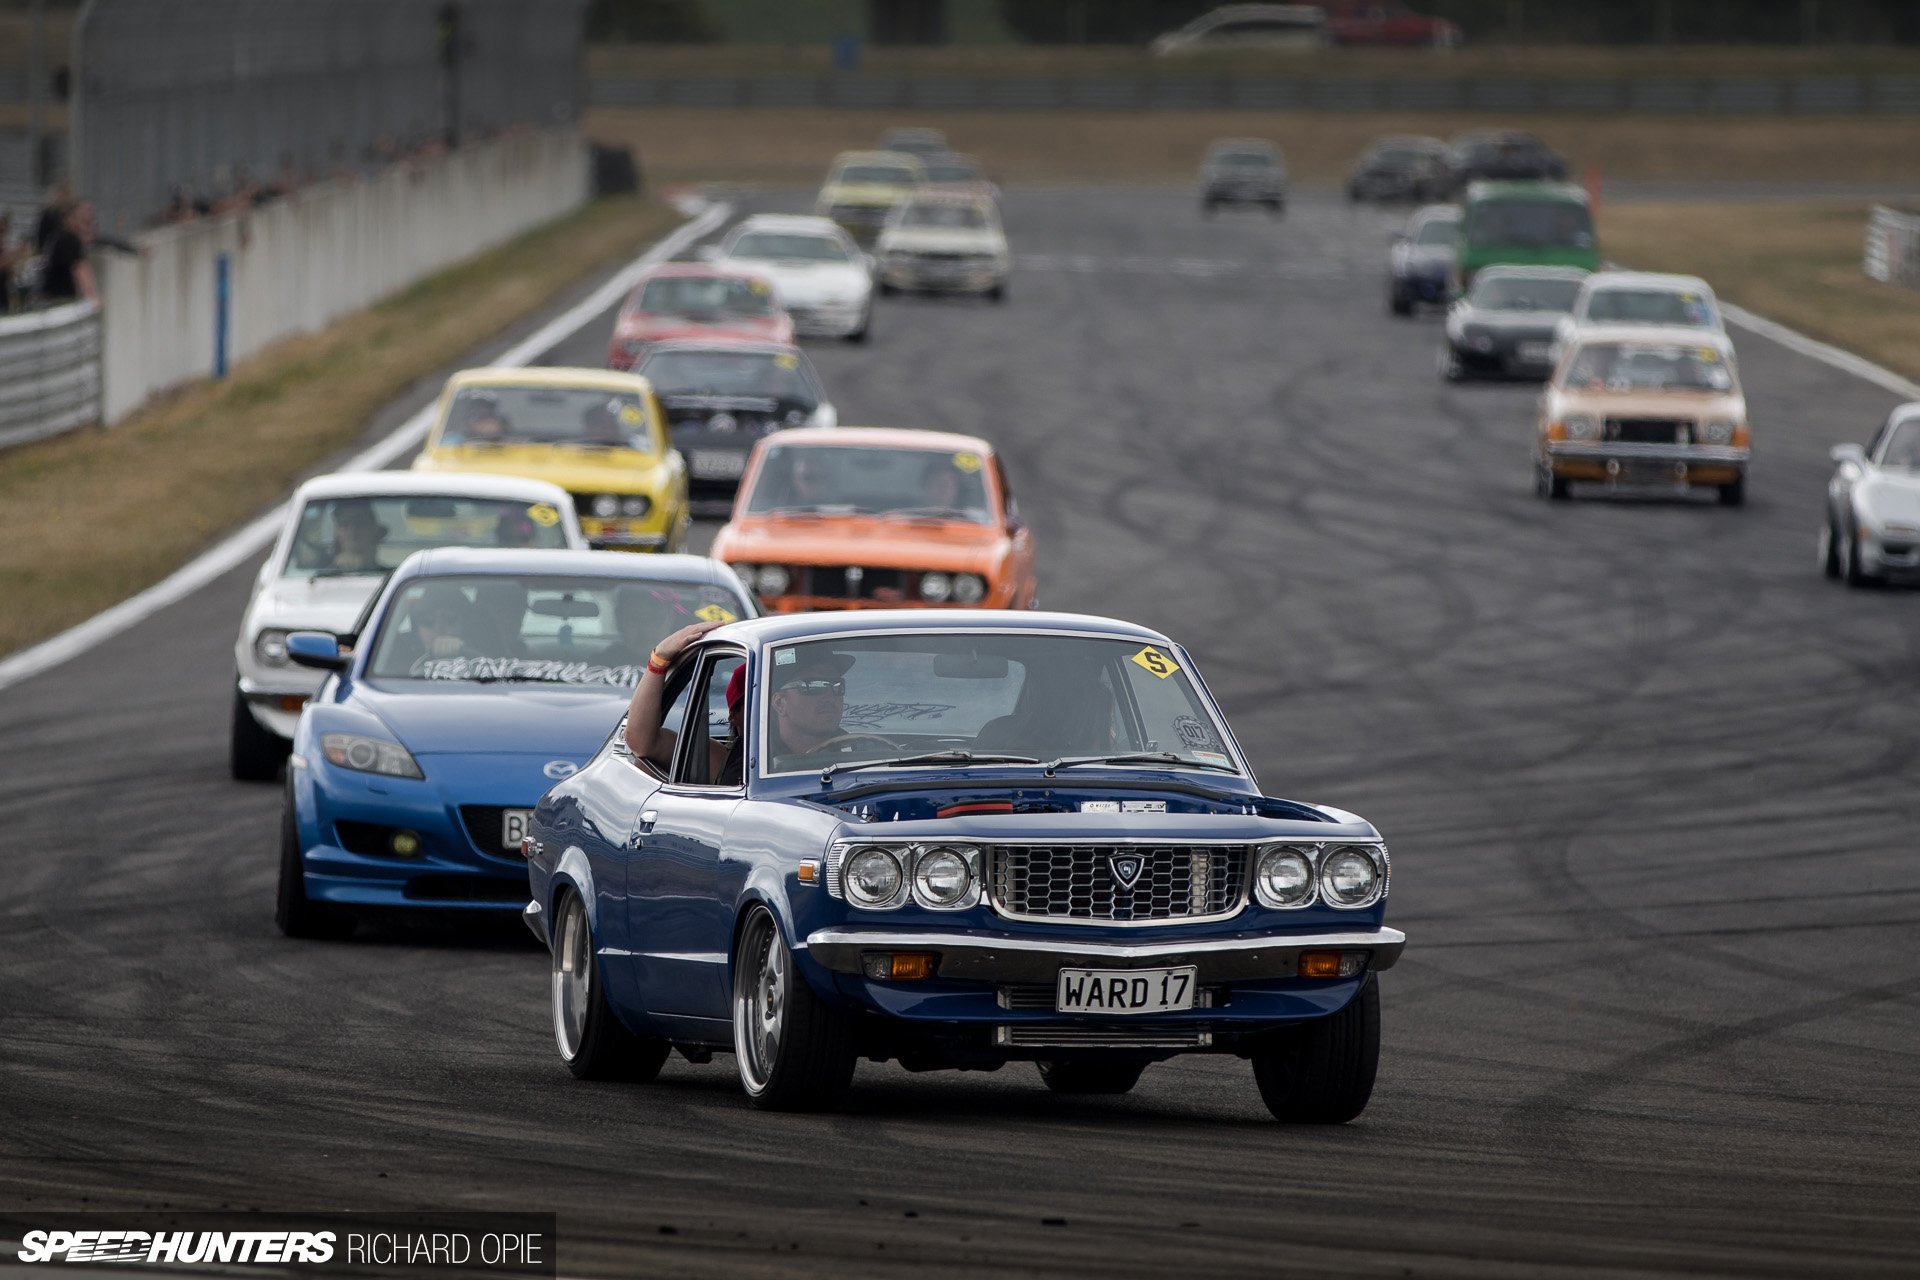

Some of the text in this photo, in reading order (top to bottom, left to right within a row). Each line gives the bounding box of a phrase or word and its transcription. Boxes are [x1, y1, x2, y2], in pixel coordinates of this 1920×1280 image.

[1144, 651, 1168, 674] S
[1182, 724, 1206, 740] 017
[1065, 974, 1190, 1008] WARD 17
